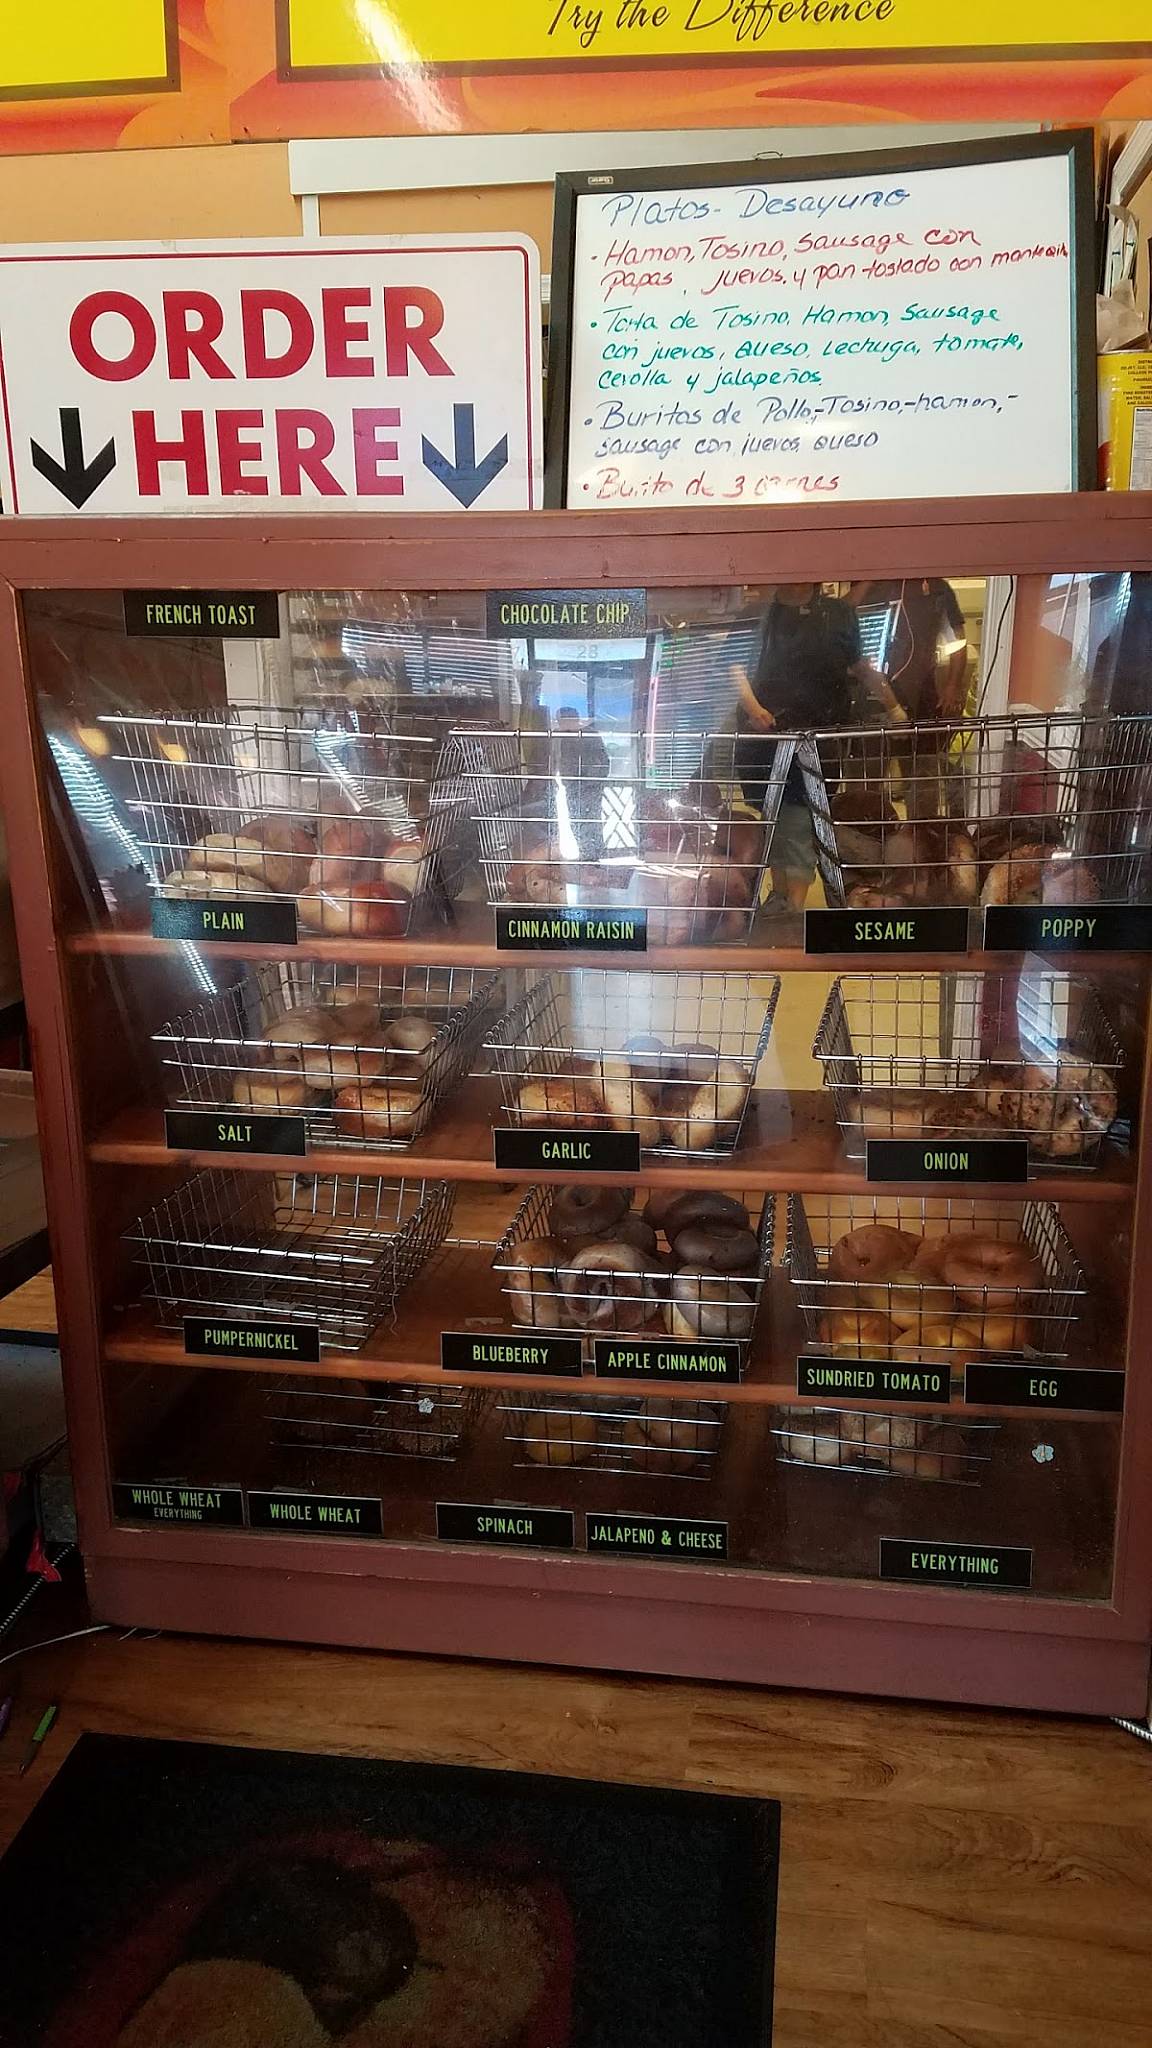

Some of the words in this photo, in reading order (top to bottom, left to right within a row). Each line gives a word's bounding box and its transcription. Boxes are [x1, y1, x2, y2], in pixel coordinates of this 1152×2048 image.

[548, 0, 602, 48] Try
[616, 0, 670, 29] the
[684, 0, 896, 42] Difference
[735, 188, 911, 219] Desayuno
[924, 229, 981, 246] con
[670, 310, 698, 329] de
[69, 286, 456, 382] ORDER
[686, 373, 700, 393] y
[596, 400, 701, 430] Buritos
[712, 401, 741, 424] de
[131, 407, 405, 496] HERE
[694, 438, 731, 454] con
[722, 475, 745, 498] 3
[146, 604, 201, 626] FRENCH
[208, 604, 256, 626] TOAST
[500, 604, 588, 625] CHOCOLATE
[596, 604, 630, 624] CHIP
[202, 911, 245, 931] PLAIN
[507, 919, 582, 939] CINNAMON
[586, 920, 635, 940] RAISIN
[854, 920, 916, 941] SESAME
[1041, 918, 1096, 939] POPPY
[217, 1123, 253, 1143] SALT
[541, 1141, 592, 1161] GARLIC
[923, 1151, 970, 1171] ONION
[203, 1329, 299, 1351] PUMPERNICKEL
[472, 1345, 550, 1365] BLUEBERRY
[607, 1351, 651, 1370] APPLE
[657, 1353, 728, 1374] CINNAMON
[806, 1368, 876, 1389] SUNDRIED
[881, 1372, 942, 1393] TOMATO
[1029, 1378, 1059, 1398] EGG
[131, 1488, 175, 1506] WHOLE
[178, 1491, 223, 1508] WHEAT
[153, 1508, 203, 1520] EVERYTHING
[269, 1503, 314, 1521] WHOLE
[317, 1506, 362, 1525] WHEAT
[476, 1516, 534, 1536] SPINACH
[590, 1525, 656, 1546] JALAPENO
[660, 1529, 673, 1546] &
[678, 1530, 724, 1550] CHEESE
[910, 1552, 1000, 1576] EVERYTHING
